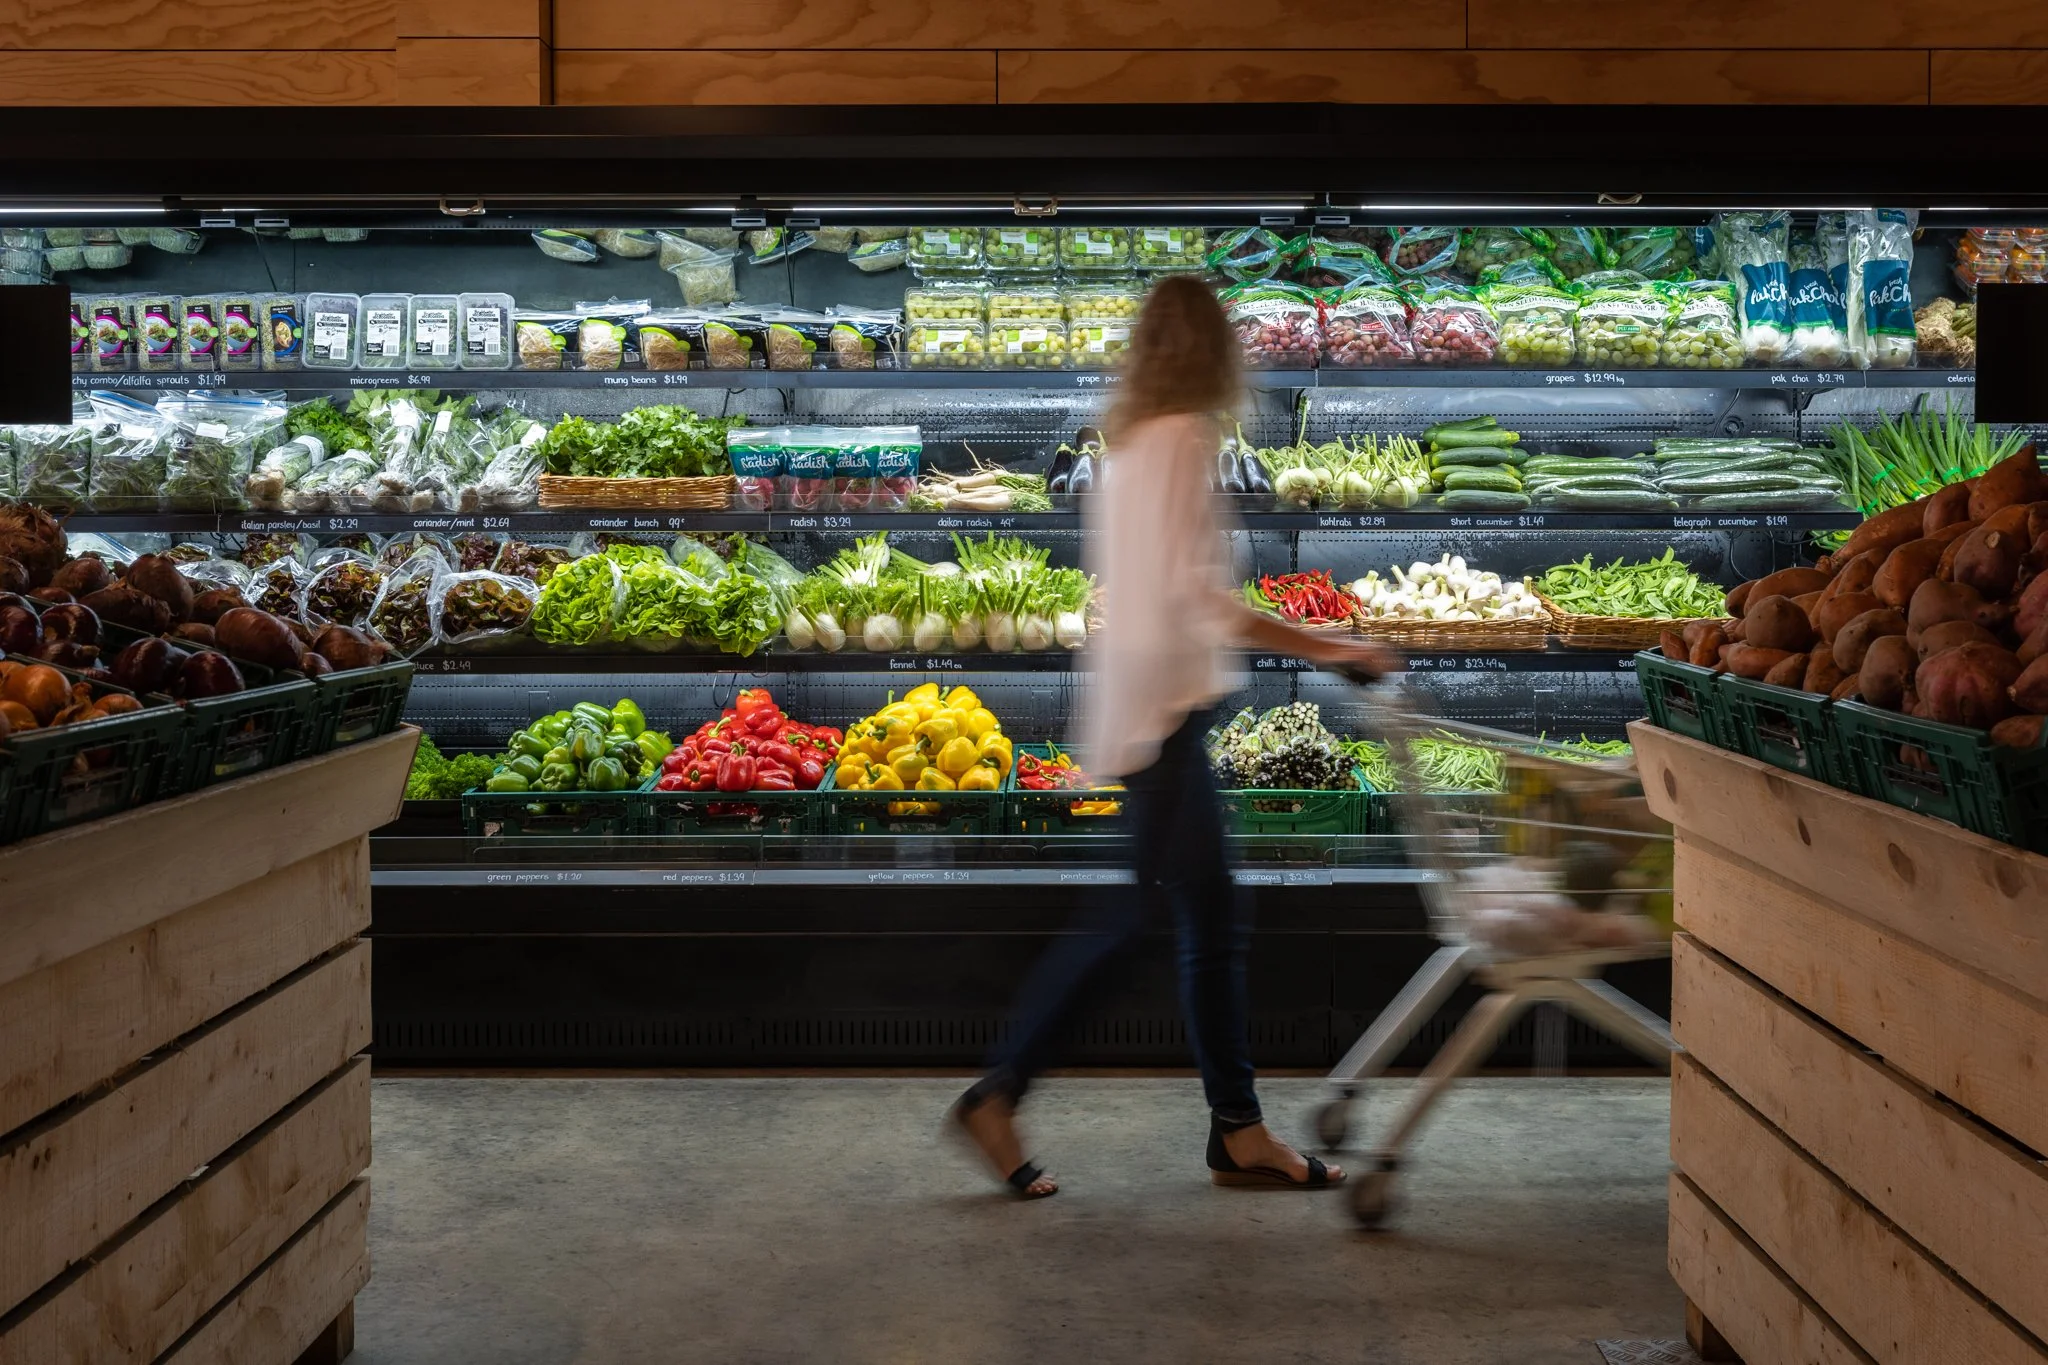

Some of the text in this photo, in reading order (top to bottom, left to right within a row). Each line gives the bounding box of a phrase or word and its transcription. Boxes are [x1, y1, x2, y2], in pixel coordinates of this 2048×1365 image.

[156, 375, 189, 388] sprouts
[198, 373, 226, 386] $1.99
[350, 374, 431, 389] microgreens $6.99
[604, 374, 688, 387] mung beans $1.99
[1076, 376, 1100, 386] grape
[1545, 375, 1575, 384] grapes
[1771, 373, 1845, 384] pak choi $2.79
[740, 454, 780, 469] Radish
[879, 453, 913, 467] adish
[241, 519, 265, 530] italian
[329, 518, 358, 530] $2.29
[413, 517, 510, 530] coriander/mint $2.69
[589, 518, 628, 527] coriander
[634, 517, 659, 528] bunch
[790, 516, 851, 528] radish $3.29
[966, 517, 992, 527] radish
[1359, 516, 1386, 526] $2.89
[1476, 517, 1514, 526] cucumber
[1518, 516, 1544, 527] $1.49
[1673, 516, 1711, 529] telegraph
[1718, 517, 1758, 527] cucumber
[442, 660, 471, 671] $2.49
[890, 659, 917, 670] fennel
[1256, 658, 1276, 668] chilli
[1409, 658, 1434, 670] garlic
[1438, 658, 1457, 669] (nz)
[487, 874, 512, 883] green
[515, 873, 550, 883] peppers
[662, 872, 745, 883] red peppers $1.39
[868, 872, 969, 882] yellow peppers $1.39
[1235, 873, 1283, 884] asparagus
